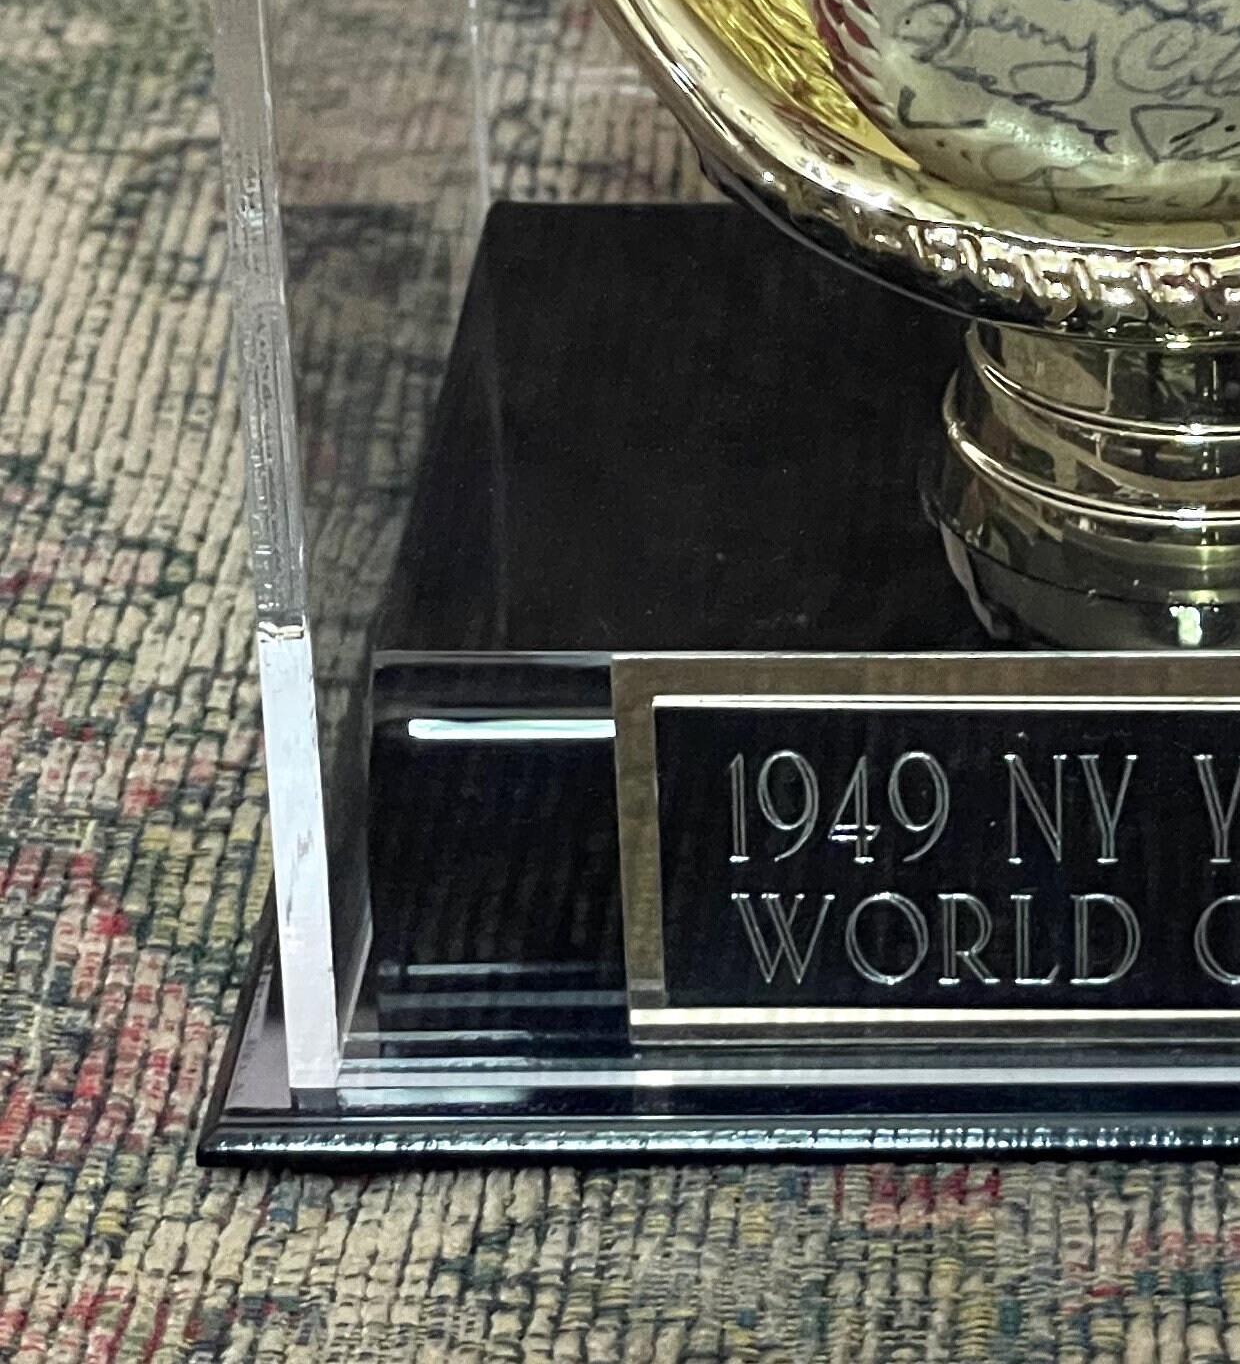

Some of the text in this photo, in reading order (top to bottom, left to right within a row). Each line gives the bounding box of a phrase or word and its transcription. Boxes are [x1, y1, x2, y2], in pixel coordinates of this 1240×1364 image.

[727, 749, 951, 865] 1949
[1007, 750, 1139, 866] NY
[731, 891, 1143, 987] WORLD
